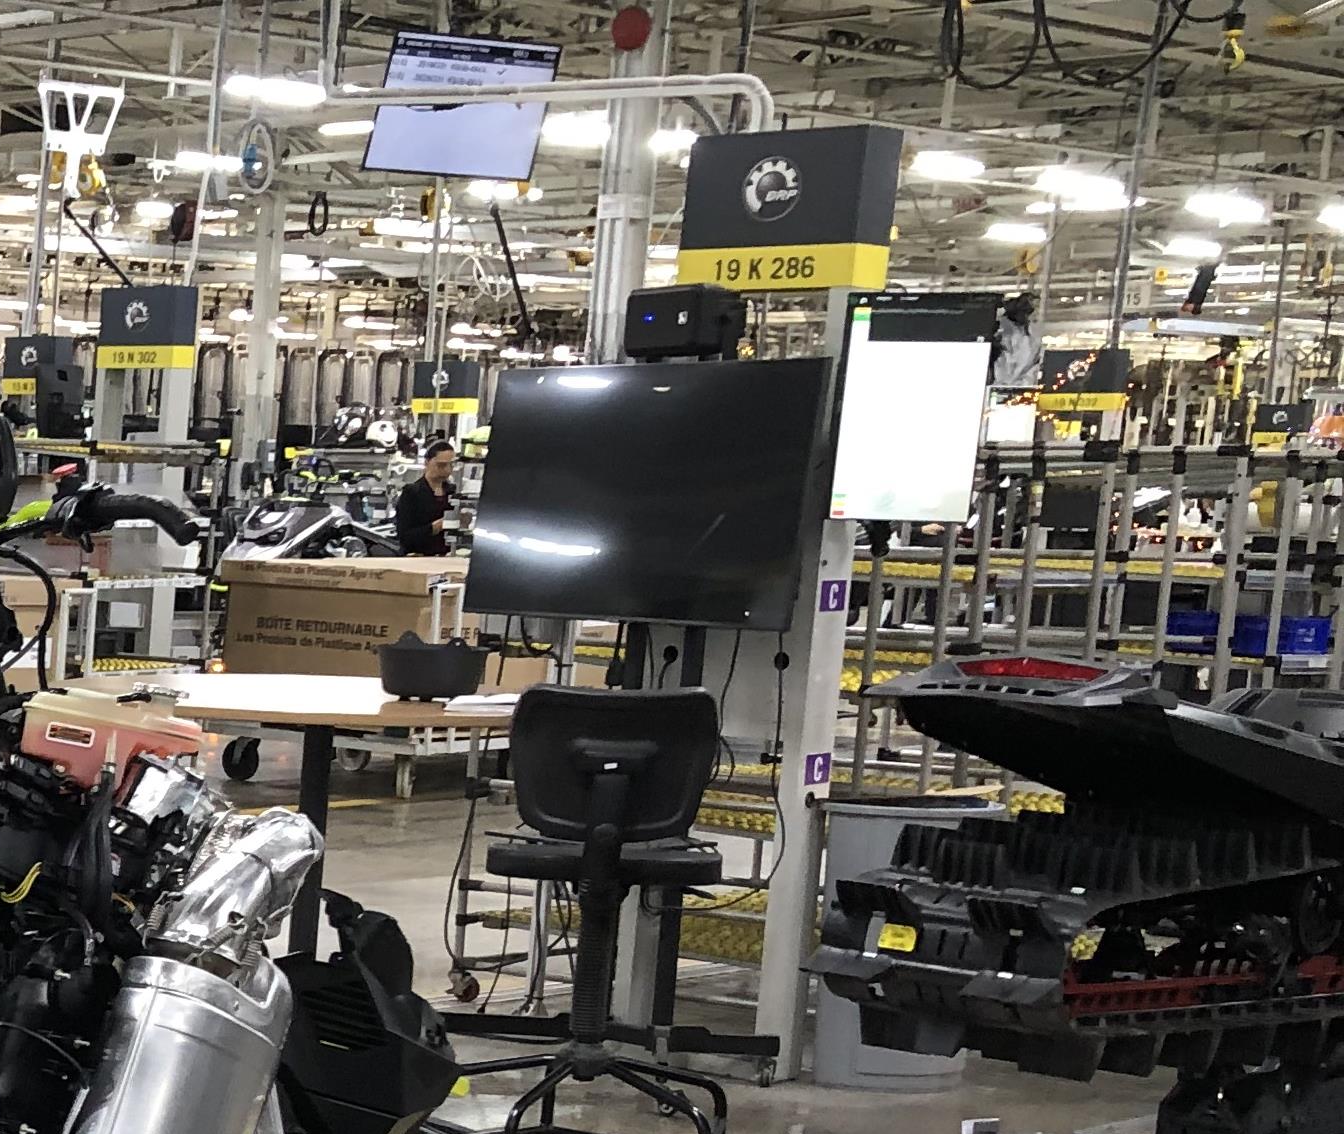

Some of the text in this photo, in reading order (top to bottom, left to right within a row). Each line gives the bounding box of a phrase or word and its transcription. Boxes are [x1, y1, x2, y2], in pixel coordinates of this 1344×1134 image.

[764, 189, 799, 202] BRP
[715, 256, 815, 281] 19 K 286
[112, 352, 158, 364] 19 N 302
[828, 583, 839, 610] C
[296, 619, 388, 638] RETOURNABLE
[813, 756, 824, 782] C
